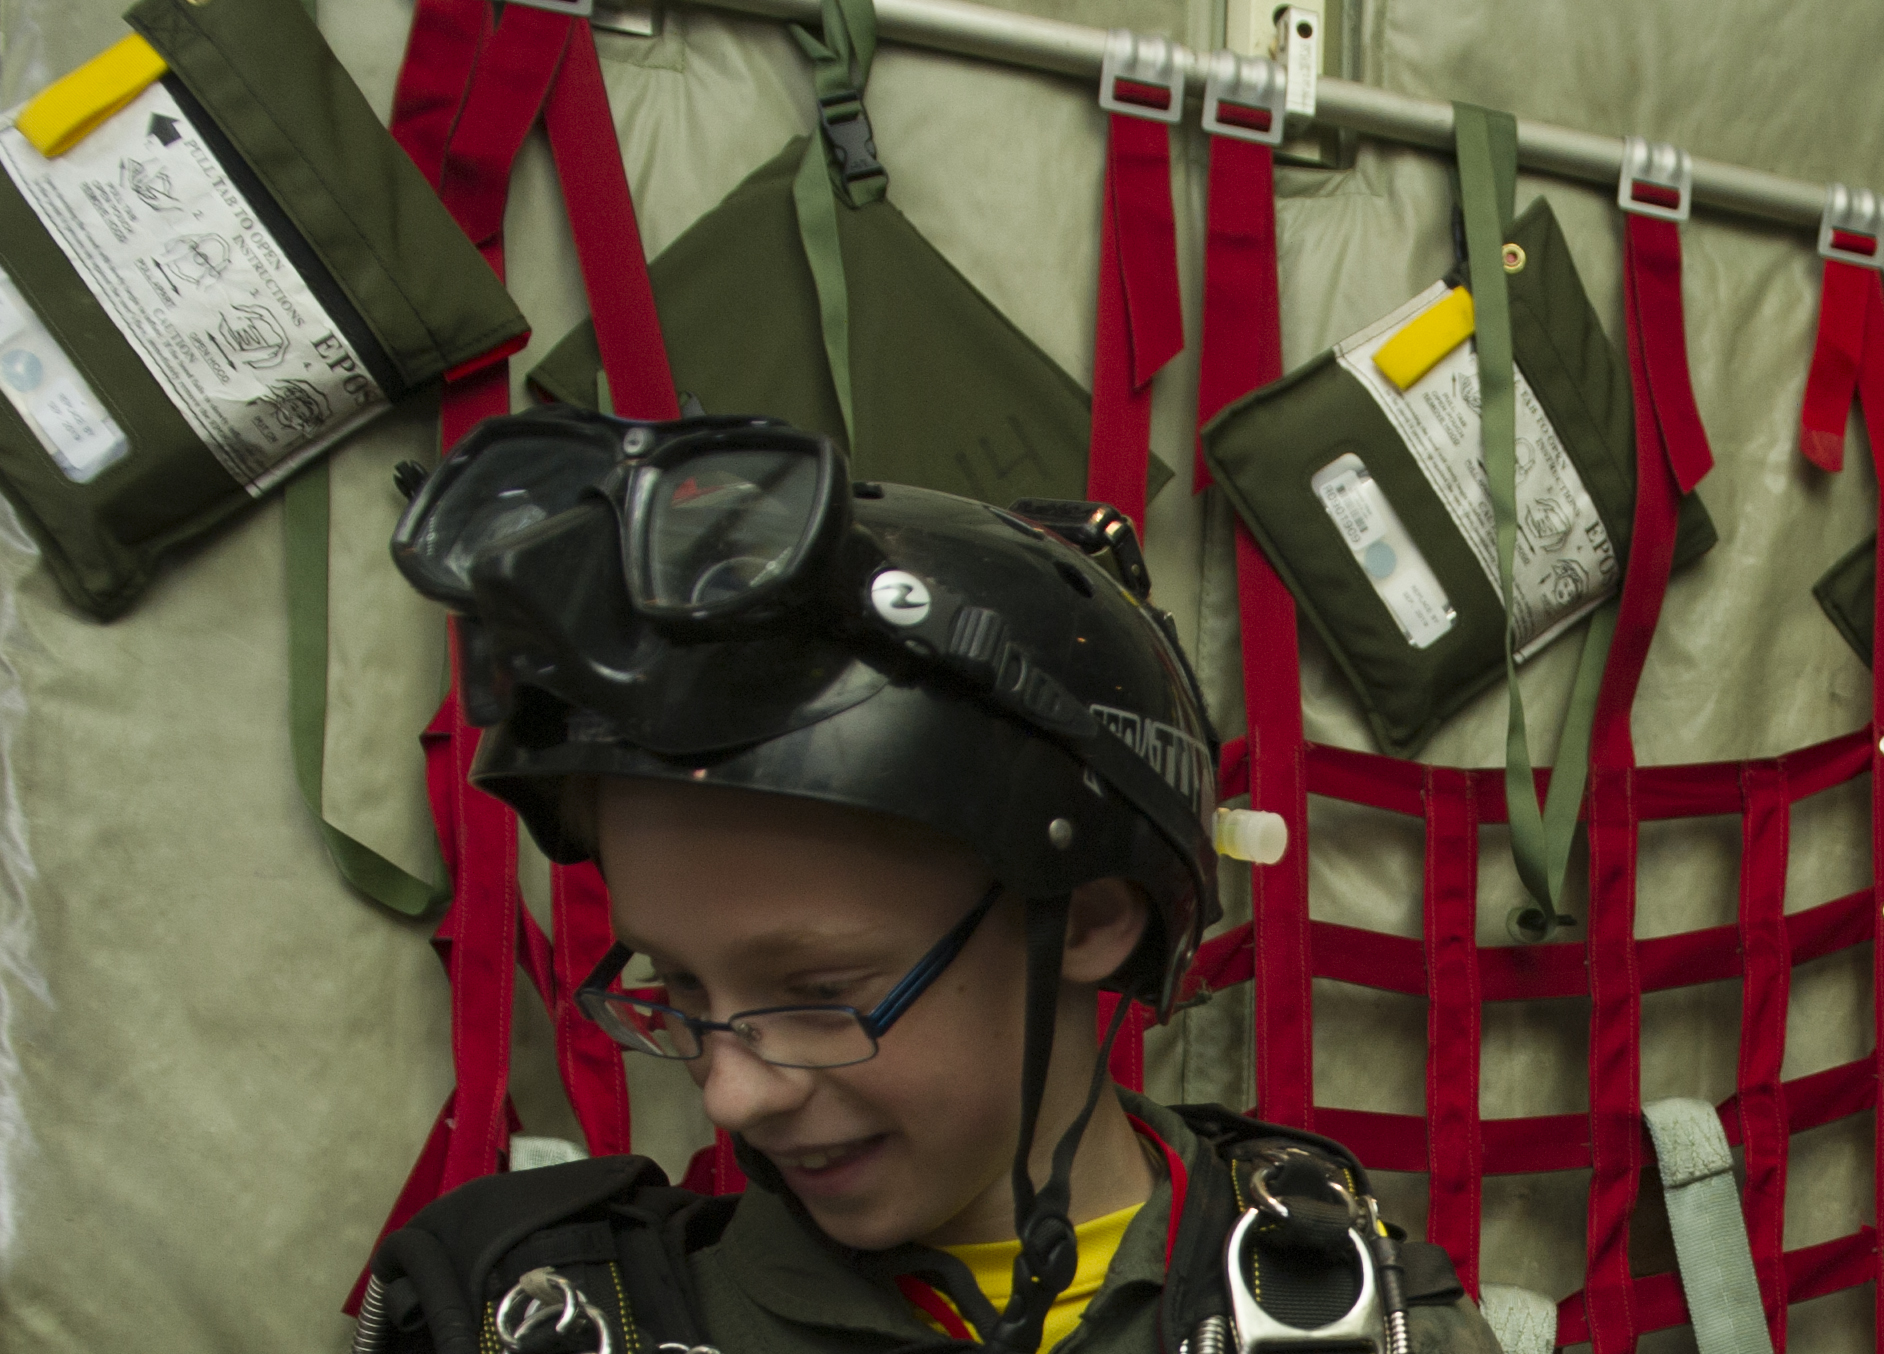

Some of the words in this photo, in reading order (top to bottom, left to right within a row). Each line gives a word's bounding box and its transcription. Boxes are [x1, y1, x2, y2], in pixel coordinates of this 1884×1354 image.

[183, 137, 217, 178] PULL
[210, 175, 239, 208] TAB
[231, 205, 255, 231] TO
[248, 228, 286, 273] OPEN
[229, 232, 307, 329] INSTRUCTIONS
[150, 305, 200, 366] CAUTION
